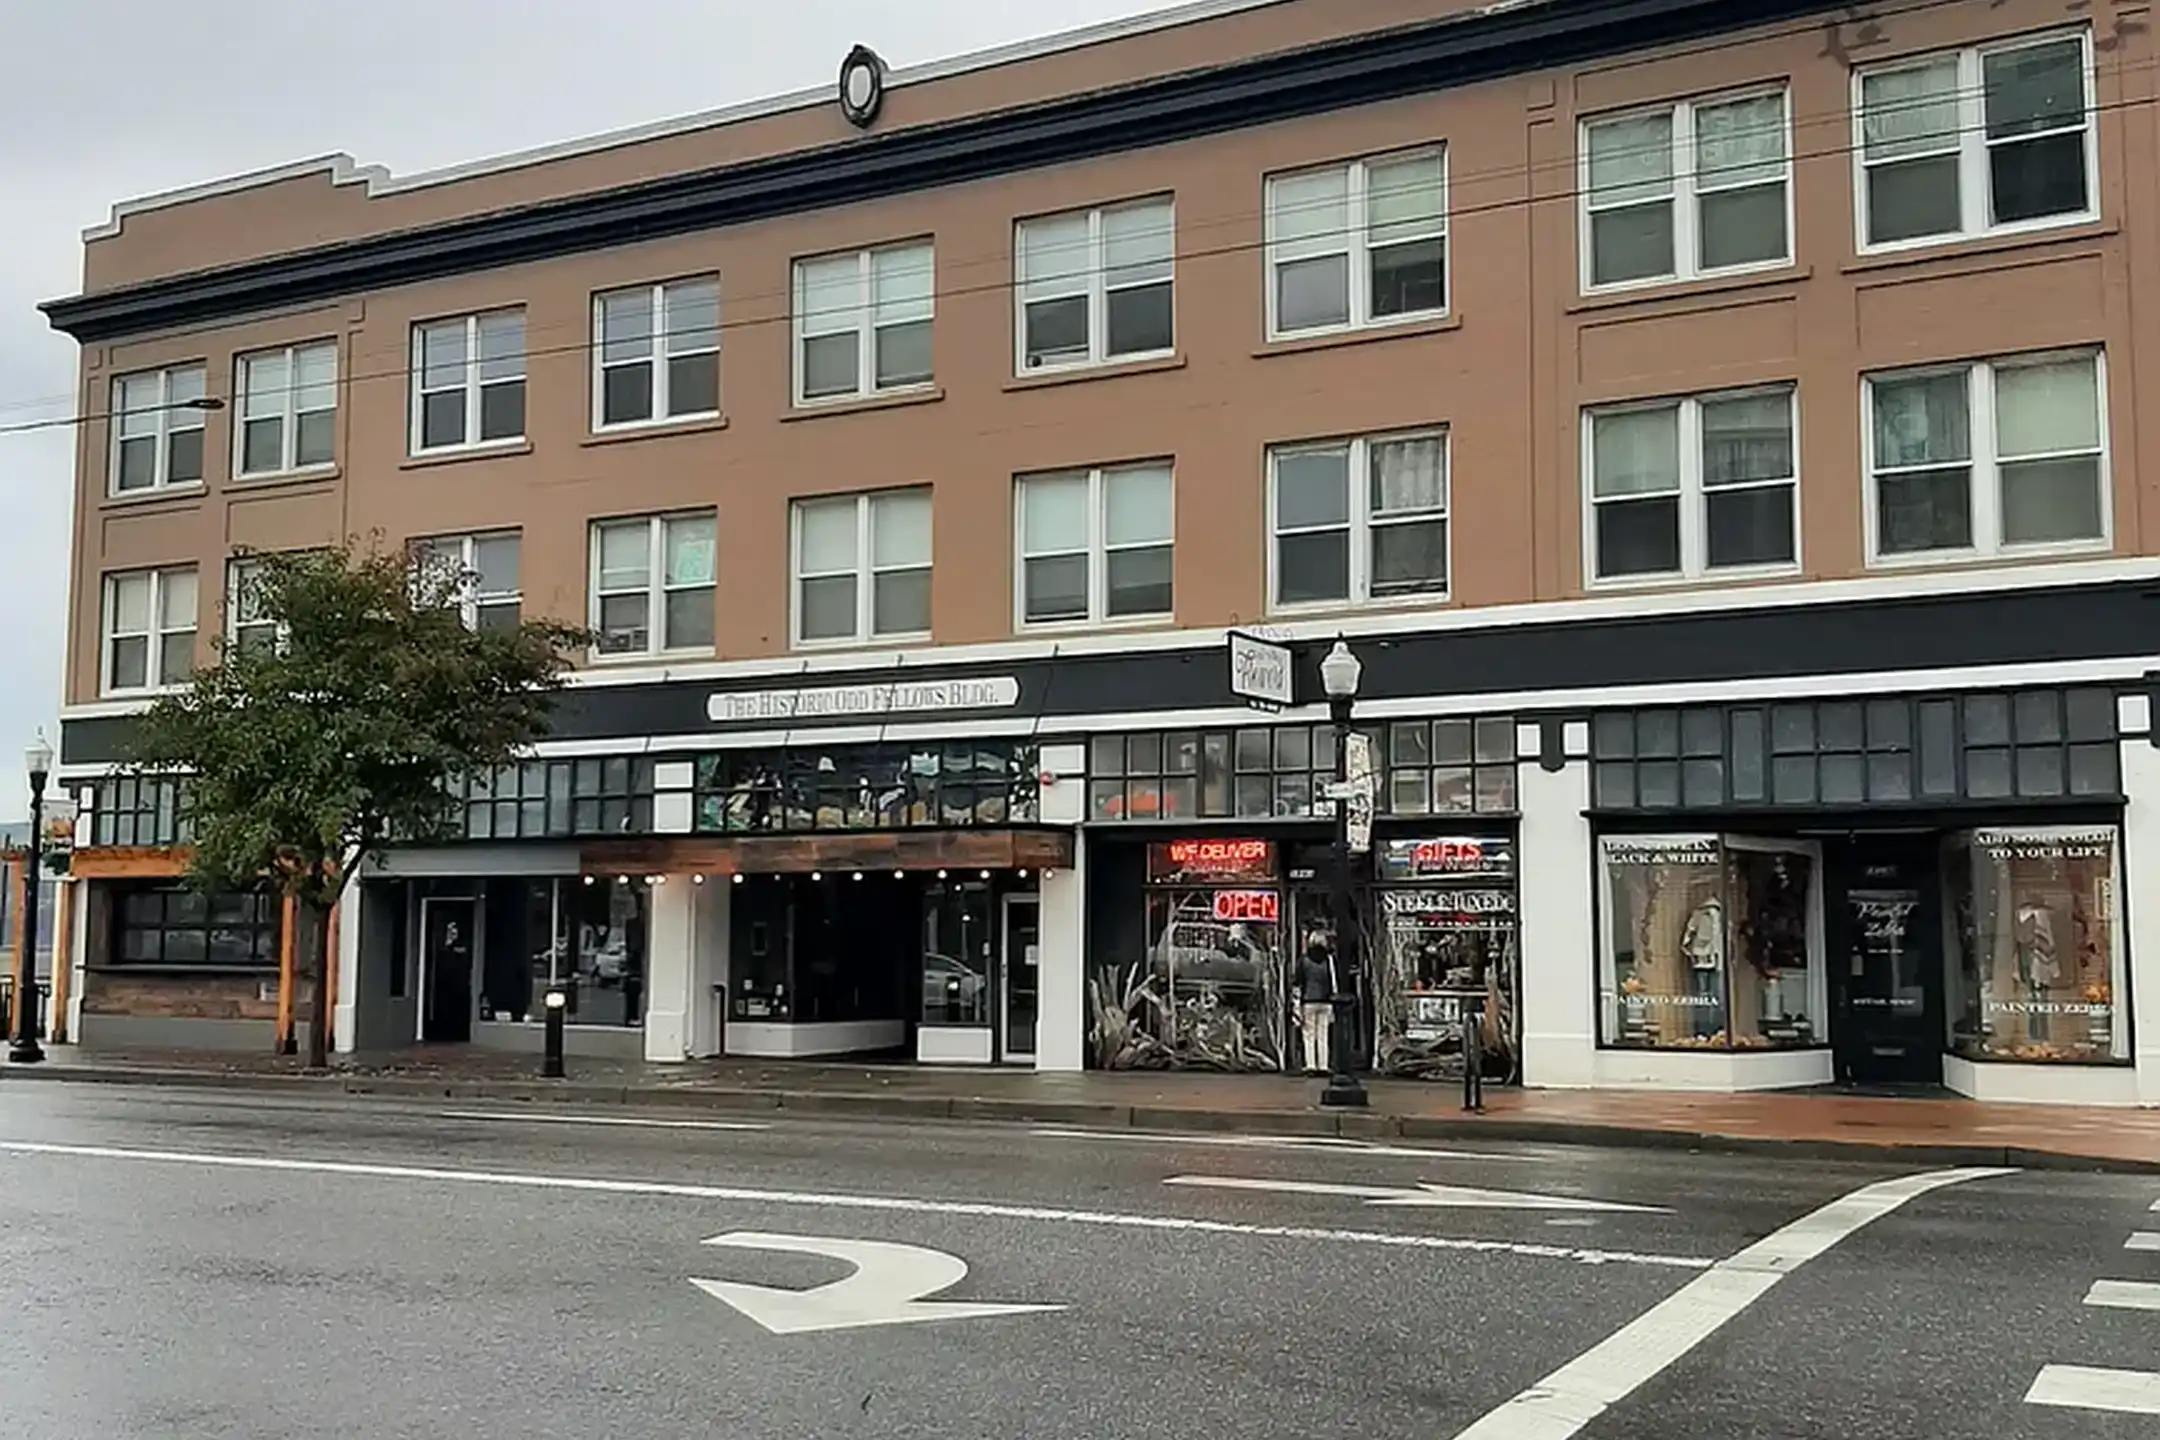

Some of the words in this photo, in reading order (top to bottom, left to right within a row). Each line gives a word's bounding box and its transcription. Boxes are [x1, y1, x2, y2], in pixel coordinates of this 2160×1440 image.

[724, 694, 757, 718] THE
[759, 691, 832, 717] HISTORIC
[833, 689, 869, 712] ODD
[872, 686, 946, 710] FELLOWS
[1170, 844, 1198, 861] WE
[1199, 840, 1267, 859] DELIVER
[1415, 842, 1481, 862] GIFTS
[1667, 852, 1717, 864] WHITE
[1988, 847, 2012, 859] TO
[2015, 846, 2064, 859] YOUR
[2067, 845, 2107, 857] LIFE
[1215, 891, 1278, 921] OPEN
[1989, 1002, 2059, 1013] PAINTED
